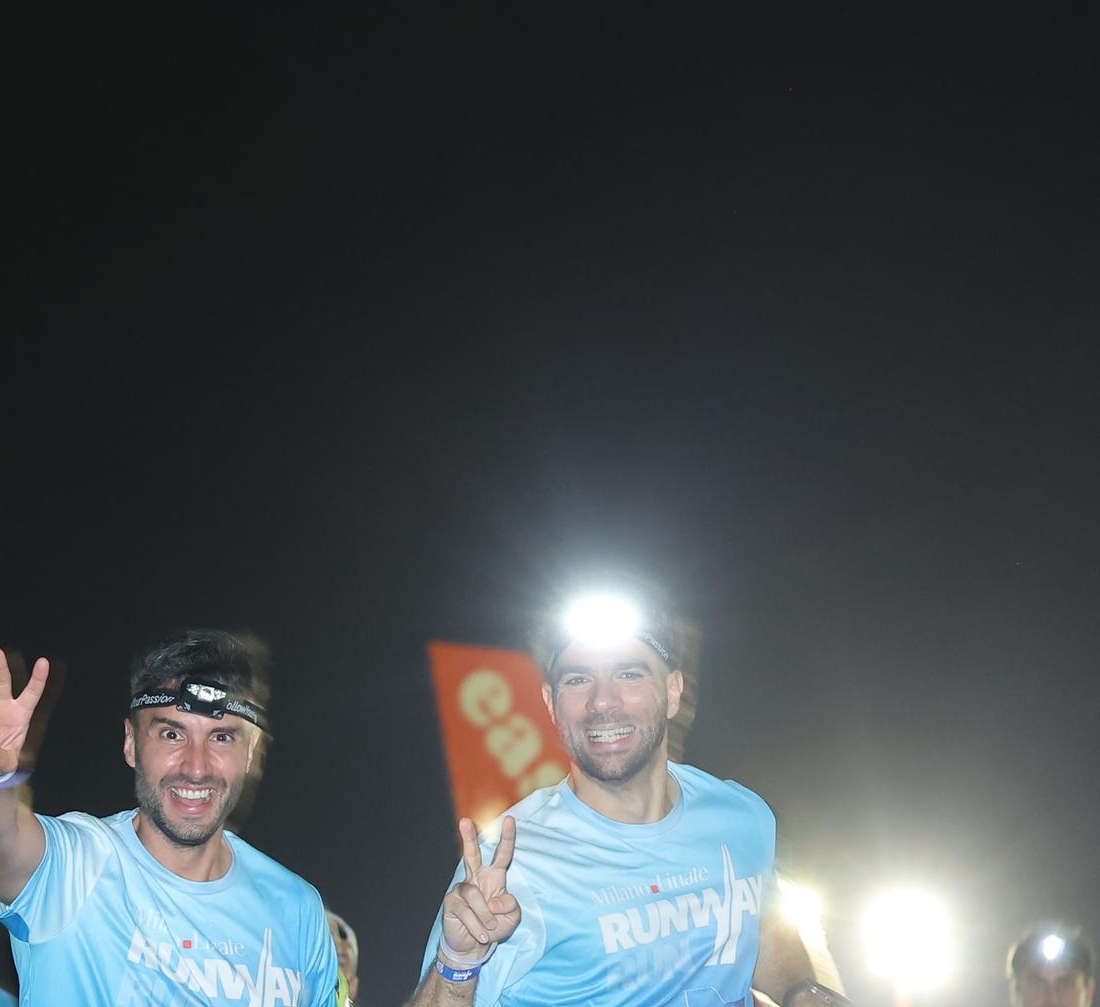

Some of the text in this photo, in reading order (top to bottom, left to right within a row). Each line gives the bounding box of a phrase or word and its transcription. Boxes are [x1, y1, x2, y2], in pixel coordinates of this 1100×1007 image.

[589, 865, 710, 906] Milano Linate
[598, 842, 763, 967] RUNWAY
